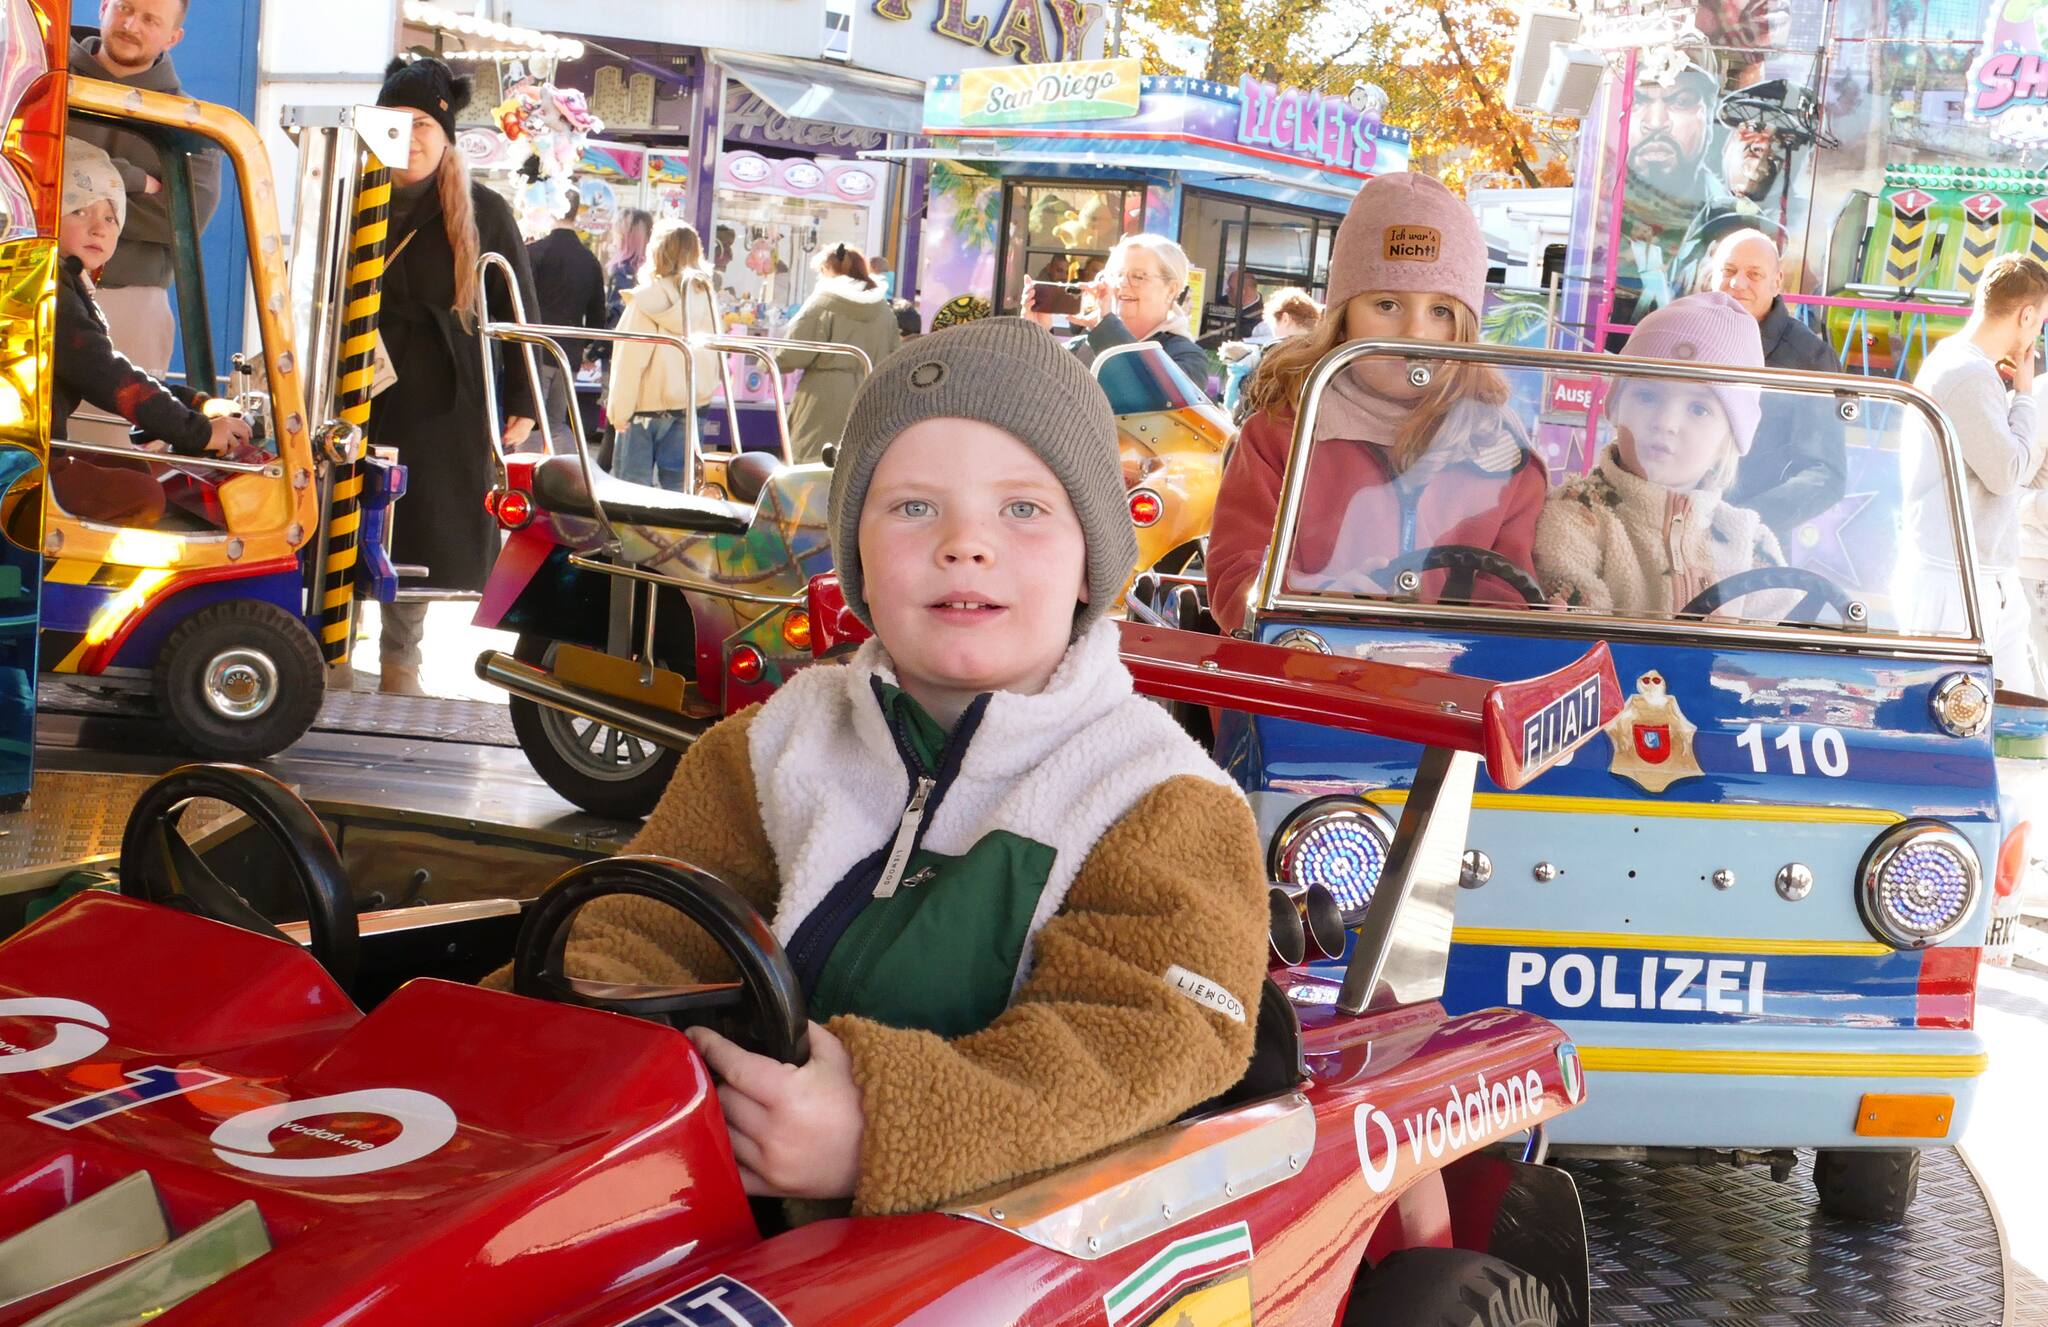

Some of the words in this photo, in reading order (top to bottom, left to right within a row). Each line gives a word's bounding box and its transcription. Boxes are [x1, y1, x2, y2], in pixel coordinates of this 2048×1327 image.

[872, 0, 1102, 64] LAY
[987, 86, 1033, 113] San
[1037, 71, 1116, 102] Diego
[1238, 72, 1381, 172] TICKETS
[1906, 193, 1916, 209] 1
[1978, 196, 1992, 212] 2
[1390, 244, 1436, 258] Nicht!
[1391, 228, 1405, 241] Ich
[1408, 231, 1436, 242] war's
[1527, 686, 1596, 769] FIAT
[1736, 722, 1849, 777] 110
[1177, 976, 1241, 1015] LIEWOOD
[1507, 952, 1767, 1013] POLIZEI
[281, 1121, 375, 1151] vodafne
[1404, 1069, 1544, 1165] vodafone
